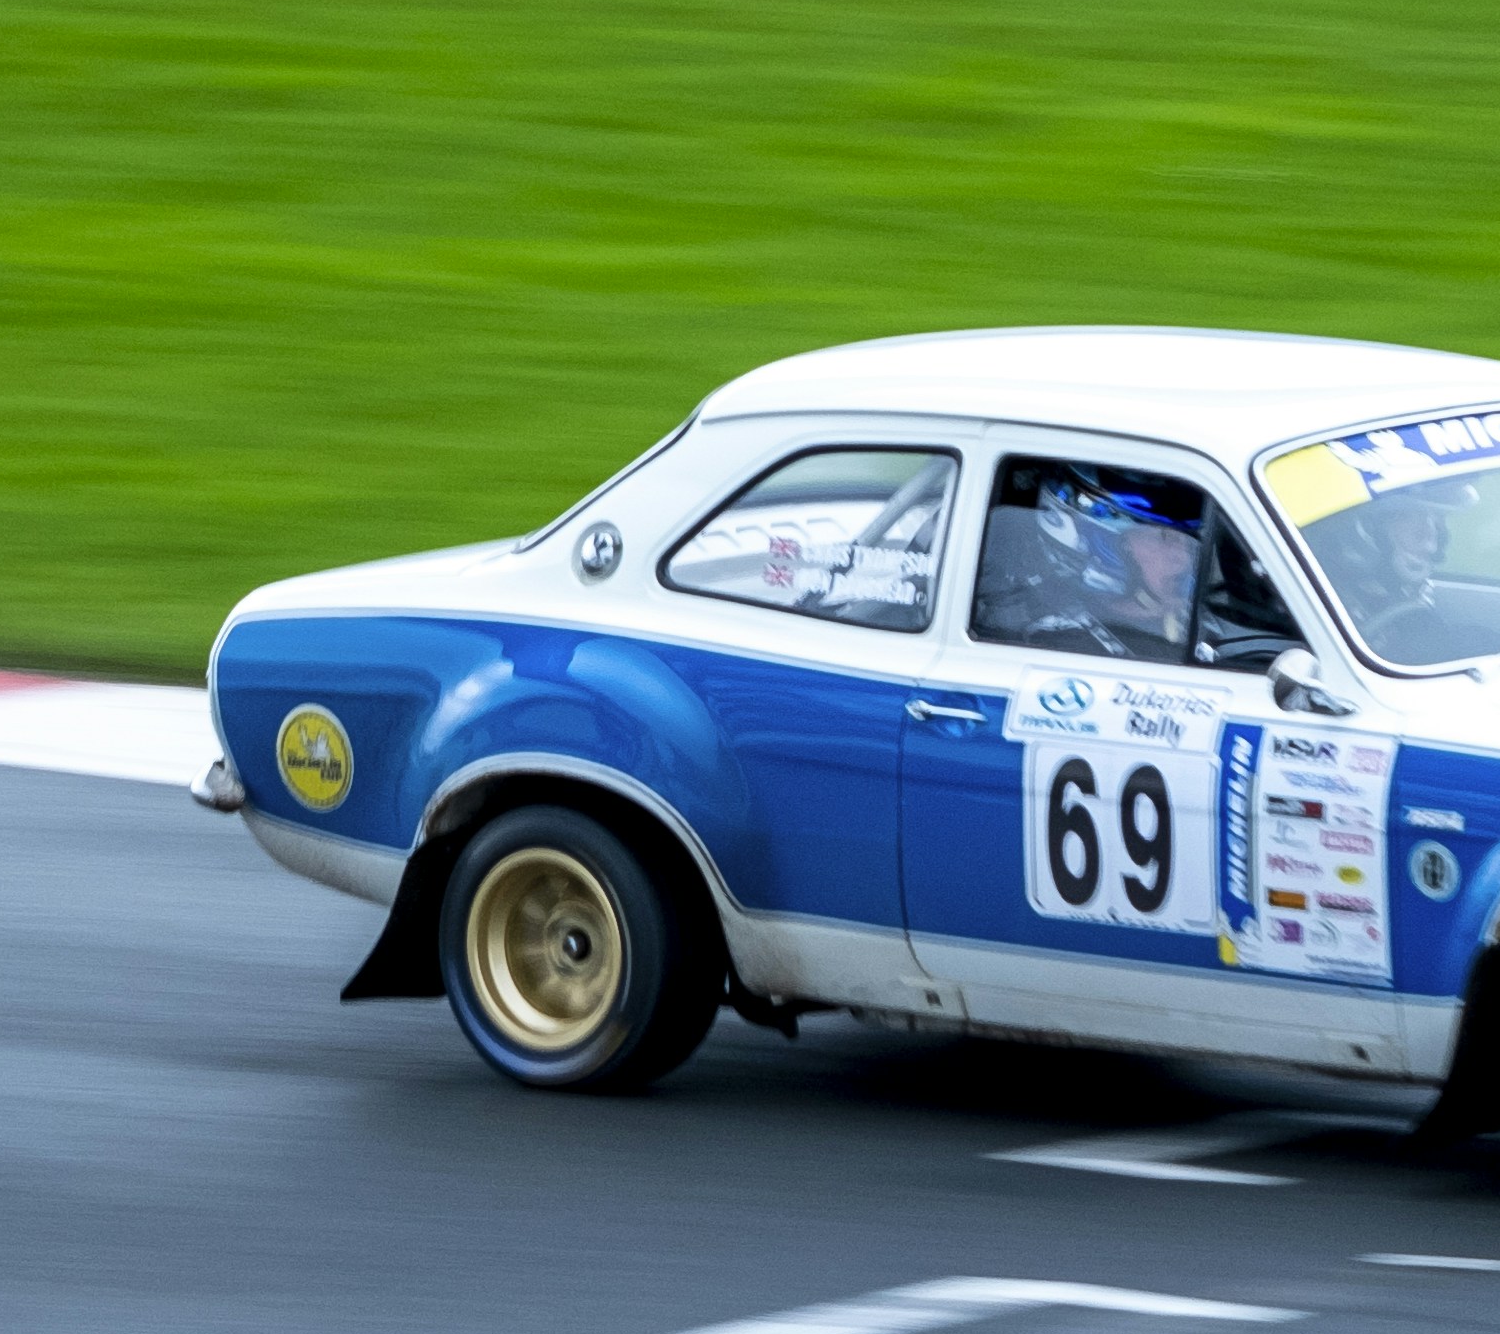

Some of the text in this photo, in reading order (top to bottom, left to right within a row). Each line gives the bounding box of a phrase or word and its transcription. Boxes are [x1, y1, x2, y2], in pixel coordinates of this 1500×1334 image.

[1124, 709, 1188, 749] Rally
[1048, 757, 1173, 914] 69
[1227, 733, 1253, 905] MICHELIN
